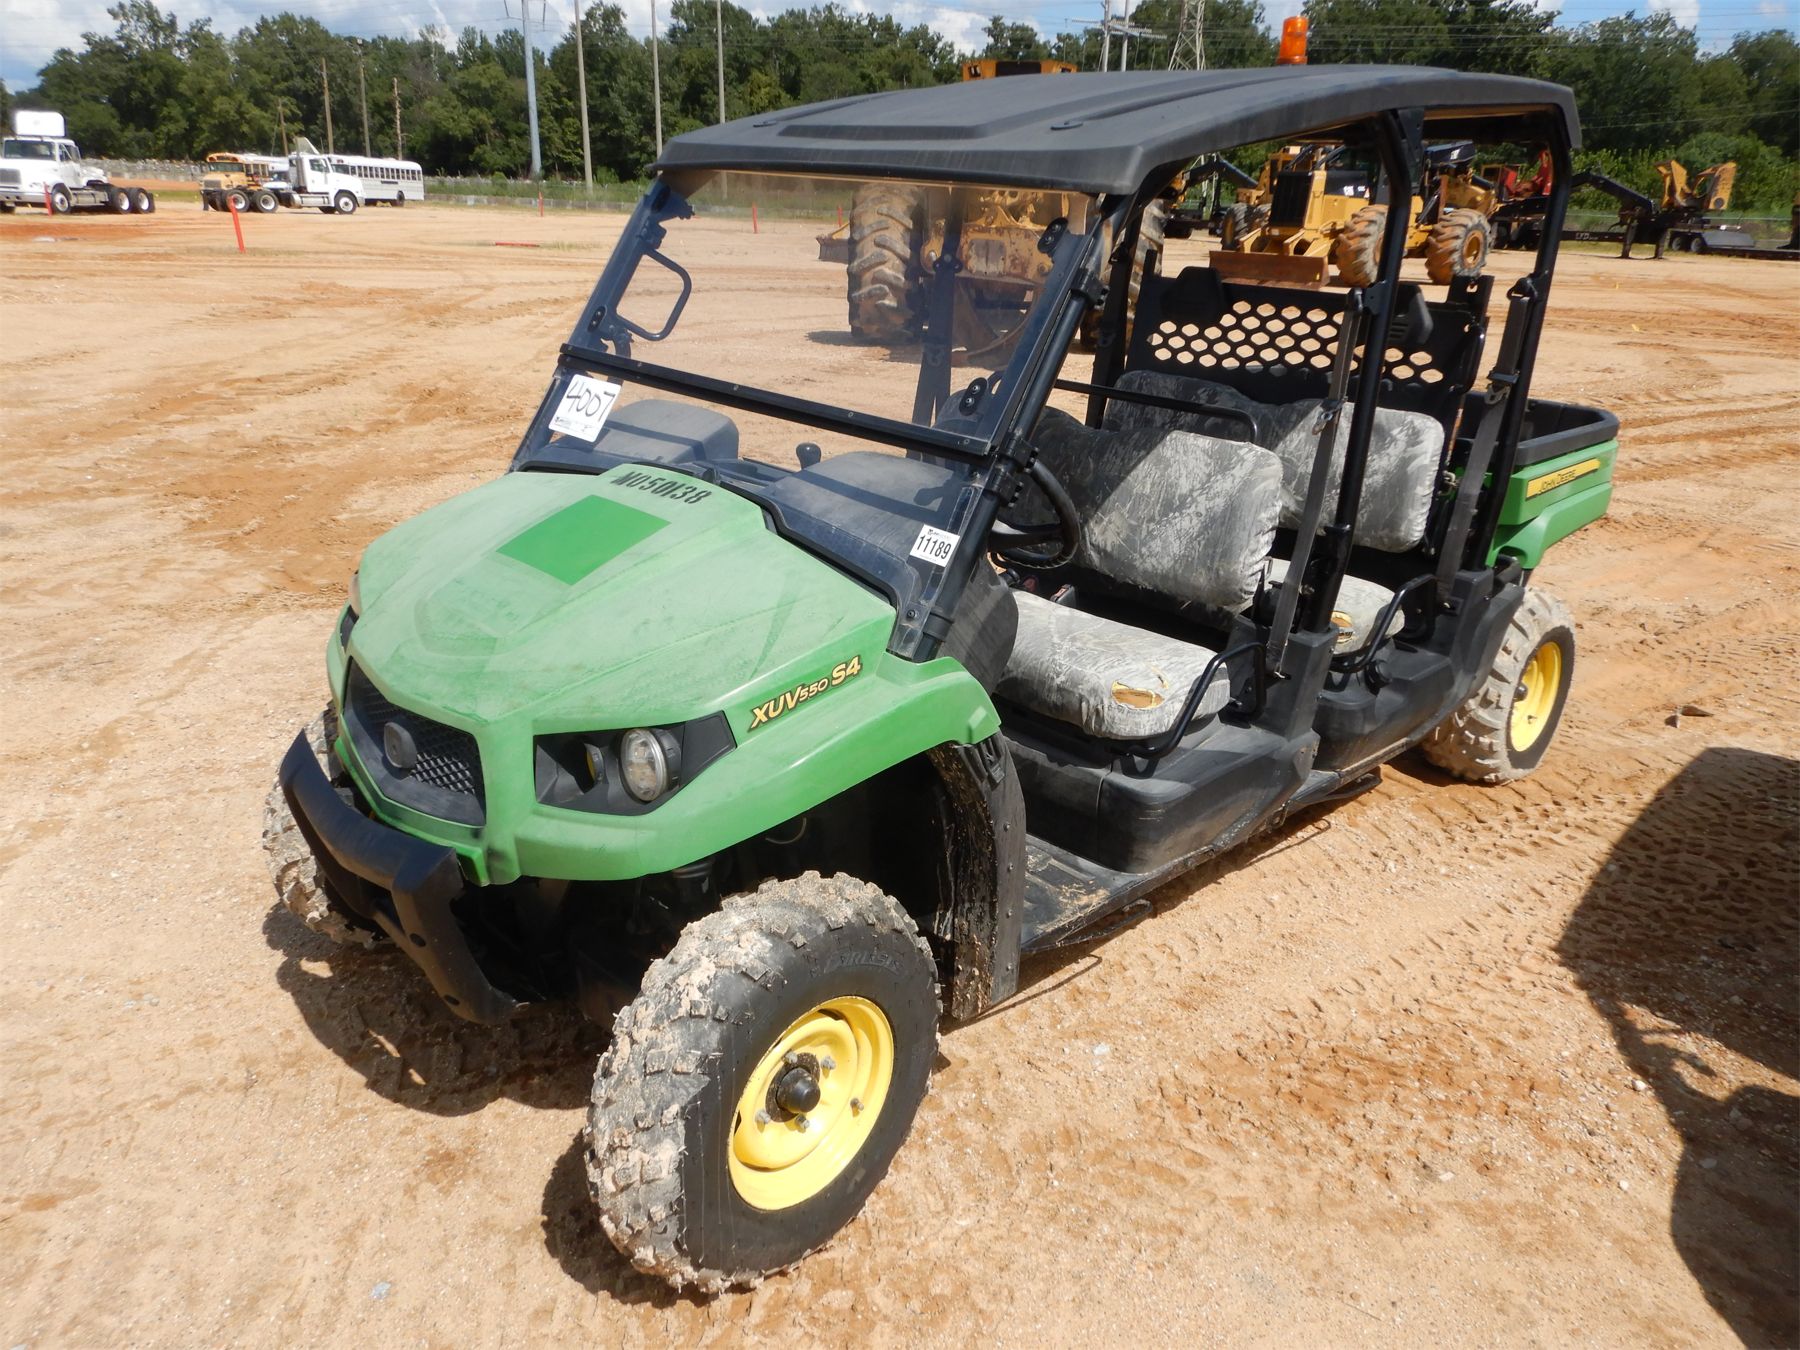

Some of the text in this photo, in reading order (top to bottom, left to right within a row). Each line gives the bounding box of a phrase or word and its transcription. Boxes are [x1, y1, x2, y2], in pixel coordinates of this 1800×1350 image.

[566, 380, 616, 423] 4007
[916, 534, 952, 560] 11189
[830, 654, 863, 687] S4
